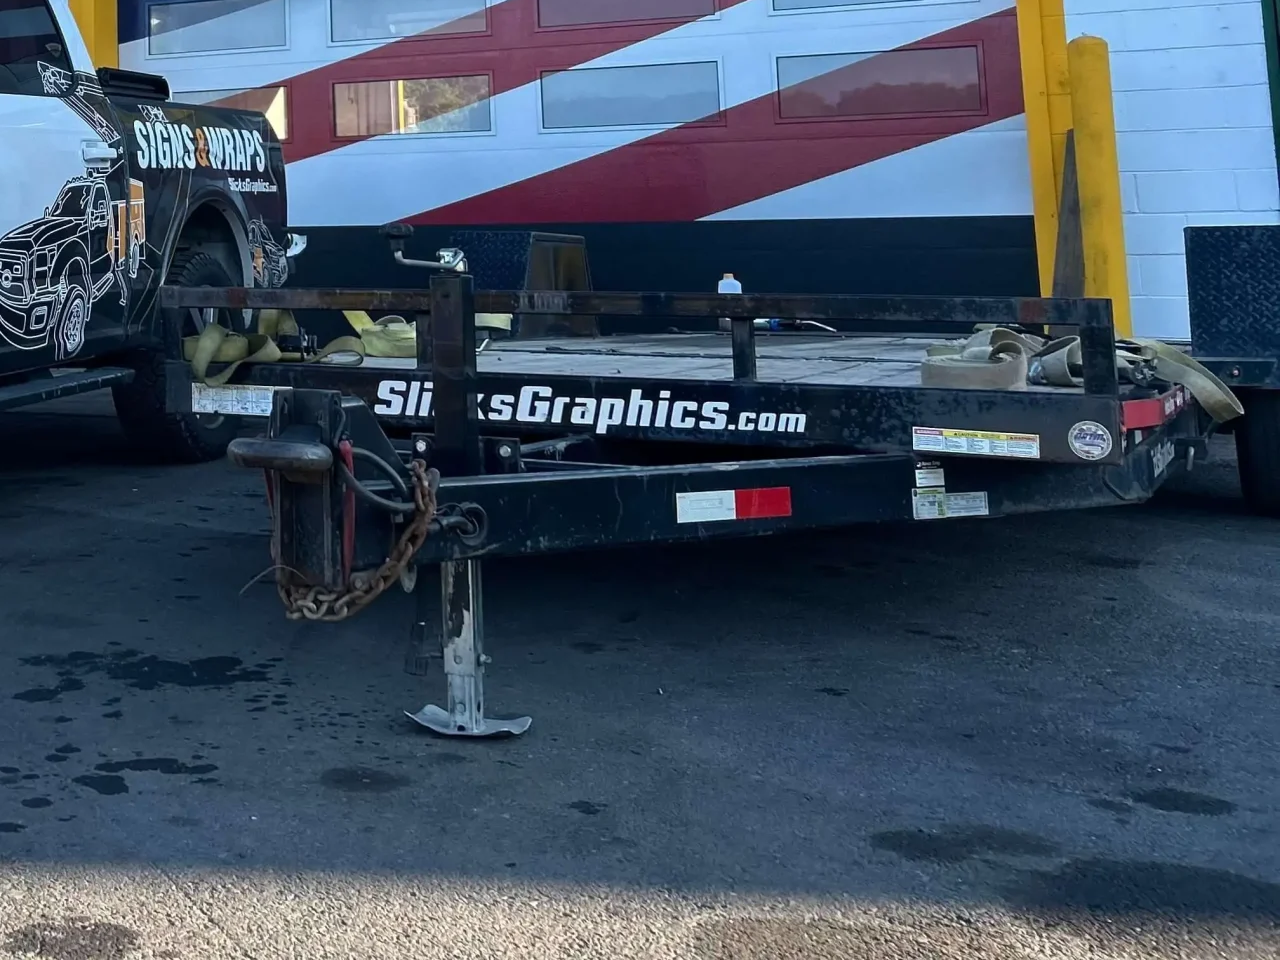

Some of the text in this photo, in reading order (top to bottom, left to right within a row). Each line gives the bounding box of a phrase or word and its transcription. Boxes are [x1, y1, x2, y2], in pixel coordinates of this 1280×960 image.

[134, 120, 265, 172] SIGNS & WRAPS
[374, 380, 806, 434] SlisGraphics.com
